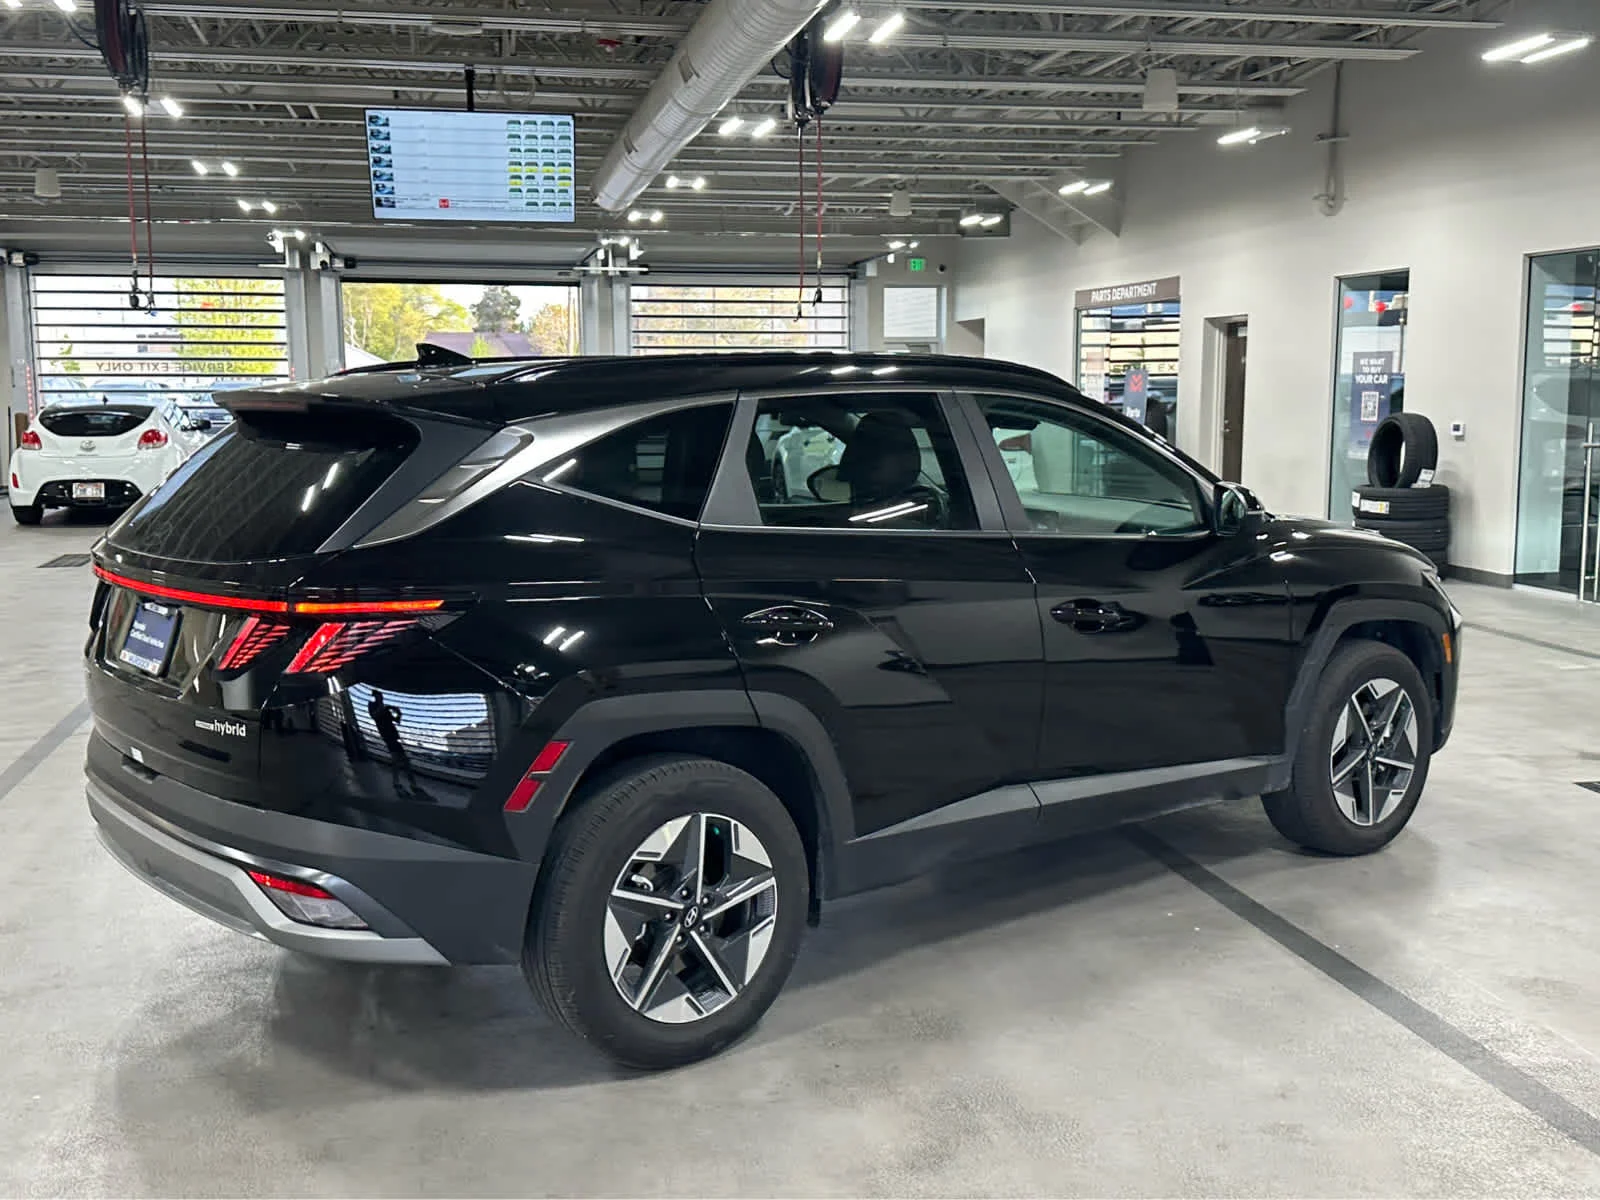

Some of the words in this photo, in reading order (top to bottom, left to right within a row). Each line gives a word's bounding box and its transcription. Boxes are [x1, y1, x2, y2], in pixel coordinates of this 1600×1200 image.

[1091, 289, 1111, 303] PARTS
[1112, 283, 1157, 301] DEPARTMENT
[1355, 375, 1373, 384] YOUR
[1373, 374, 1388, 384] CAR
[214, 719, 246, 736] hybrid
